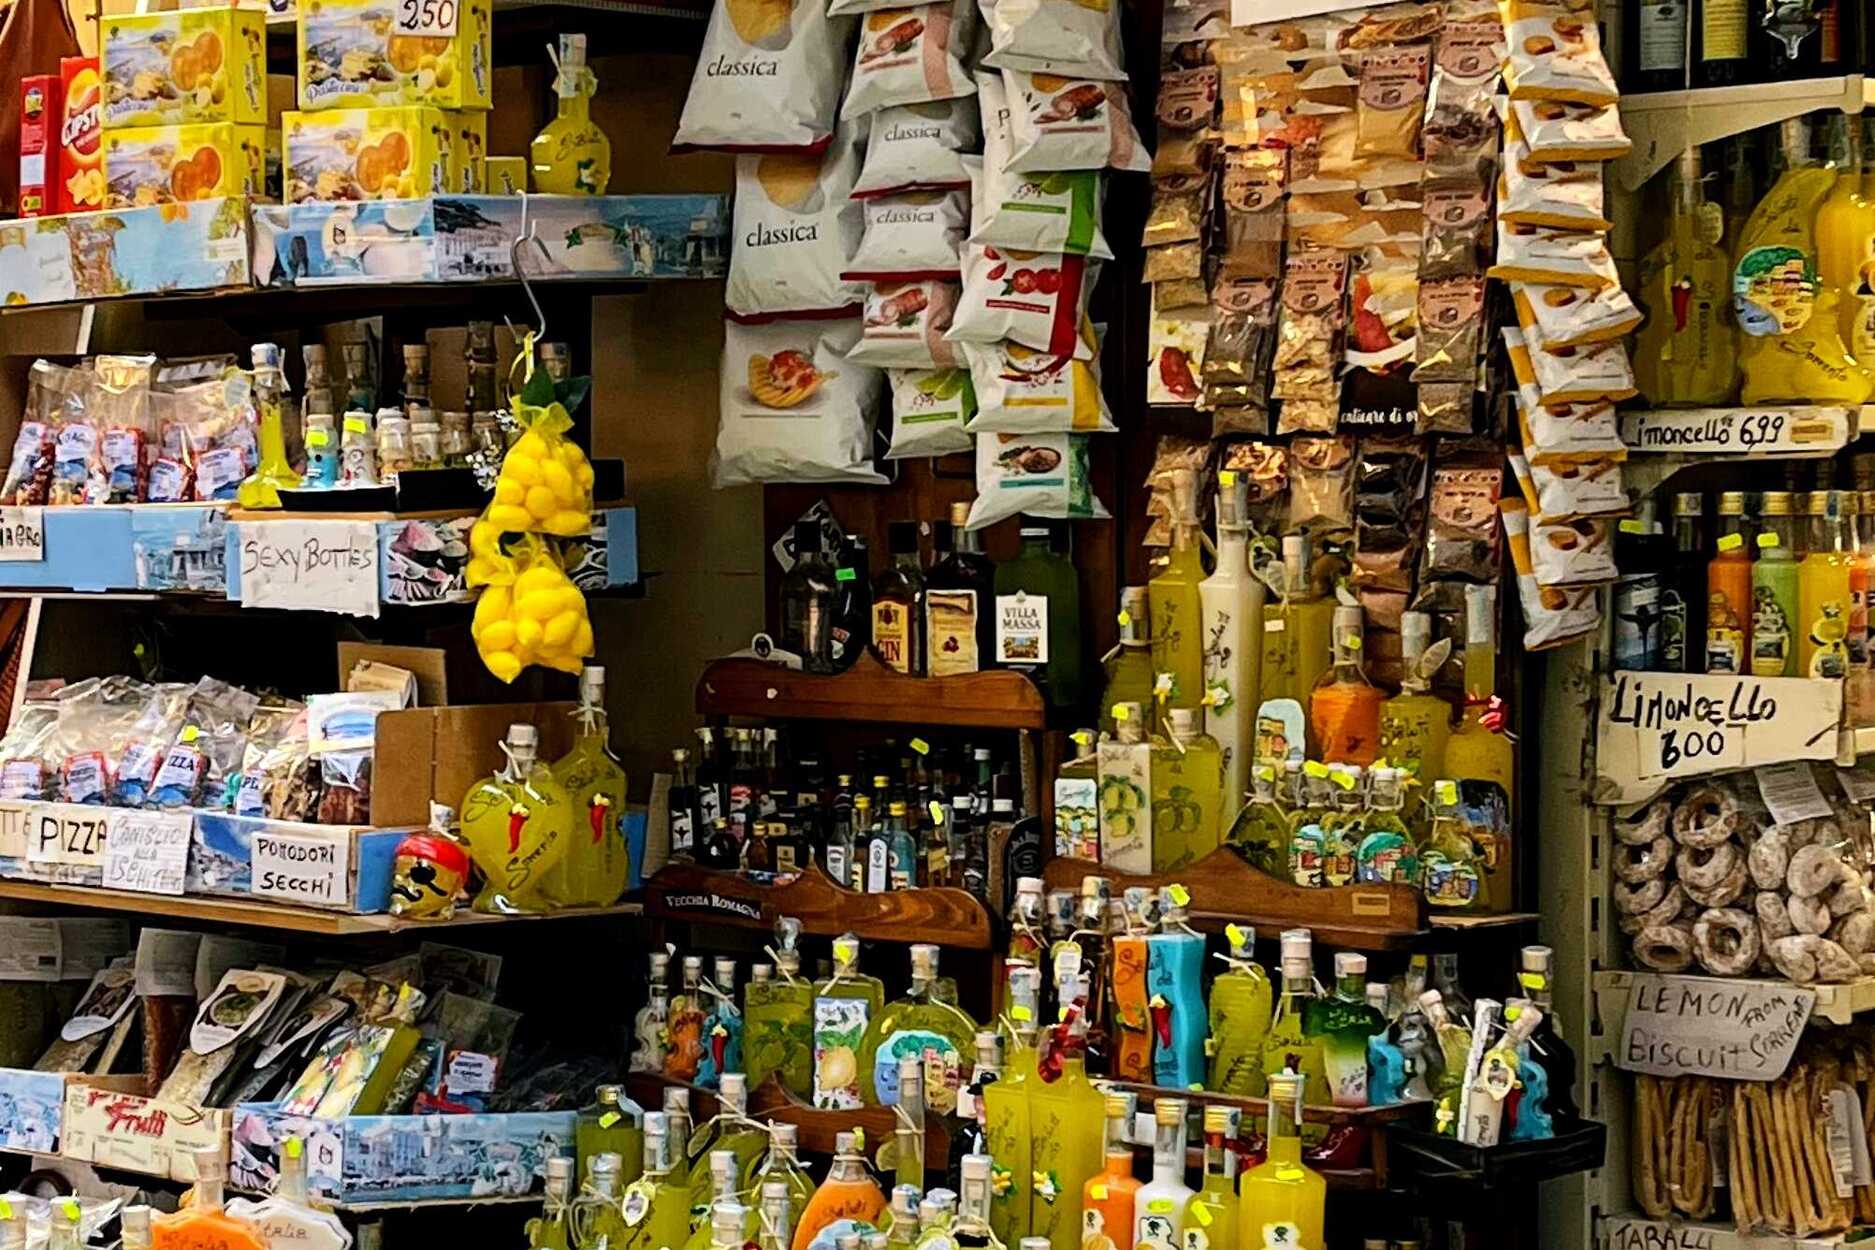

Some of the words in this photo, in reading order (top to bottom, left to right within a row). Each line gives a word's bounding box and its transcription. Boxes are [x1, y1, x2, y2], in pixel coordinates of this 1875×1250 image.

[706, 55, 778, 77] classica
[884, 123, 942, 141] classica
[876, 208, 936, 224] classica
[746, 220, 819, 248] classica
[1004, 607, 1038, 618] VILLA
[1002, 619, 1042, 629] MASSA
[40, 816, 107, 855] PIZZA
[665, 896, 709, 907] VECCHIA
[711, 894, 761, 919] ROMAGNA
[1636, 985, 1748, 1017] LEMON
